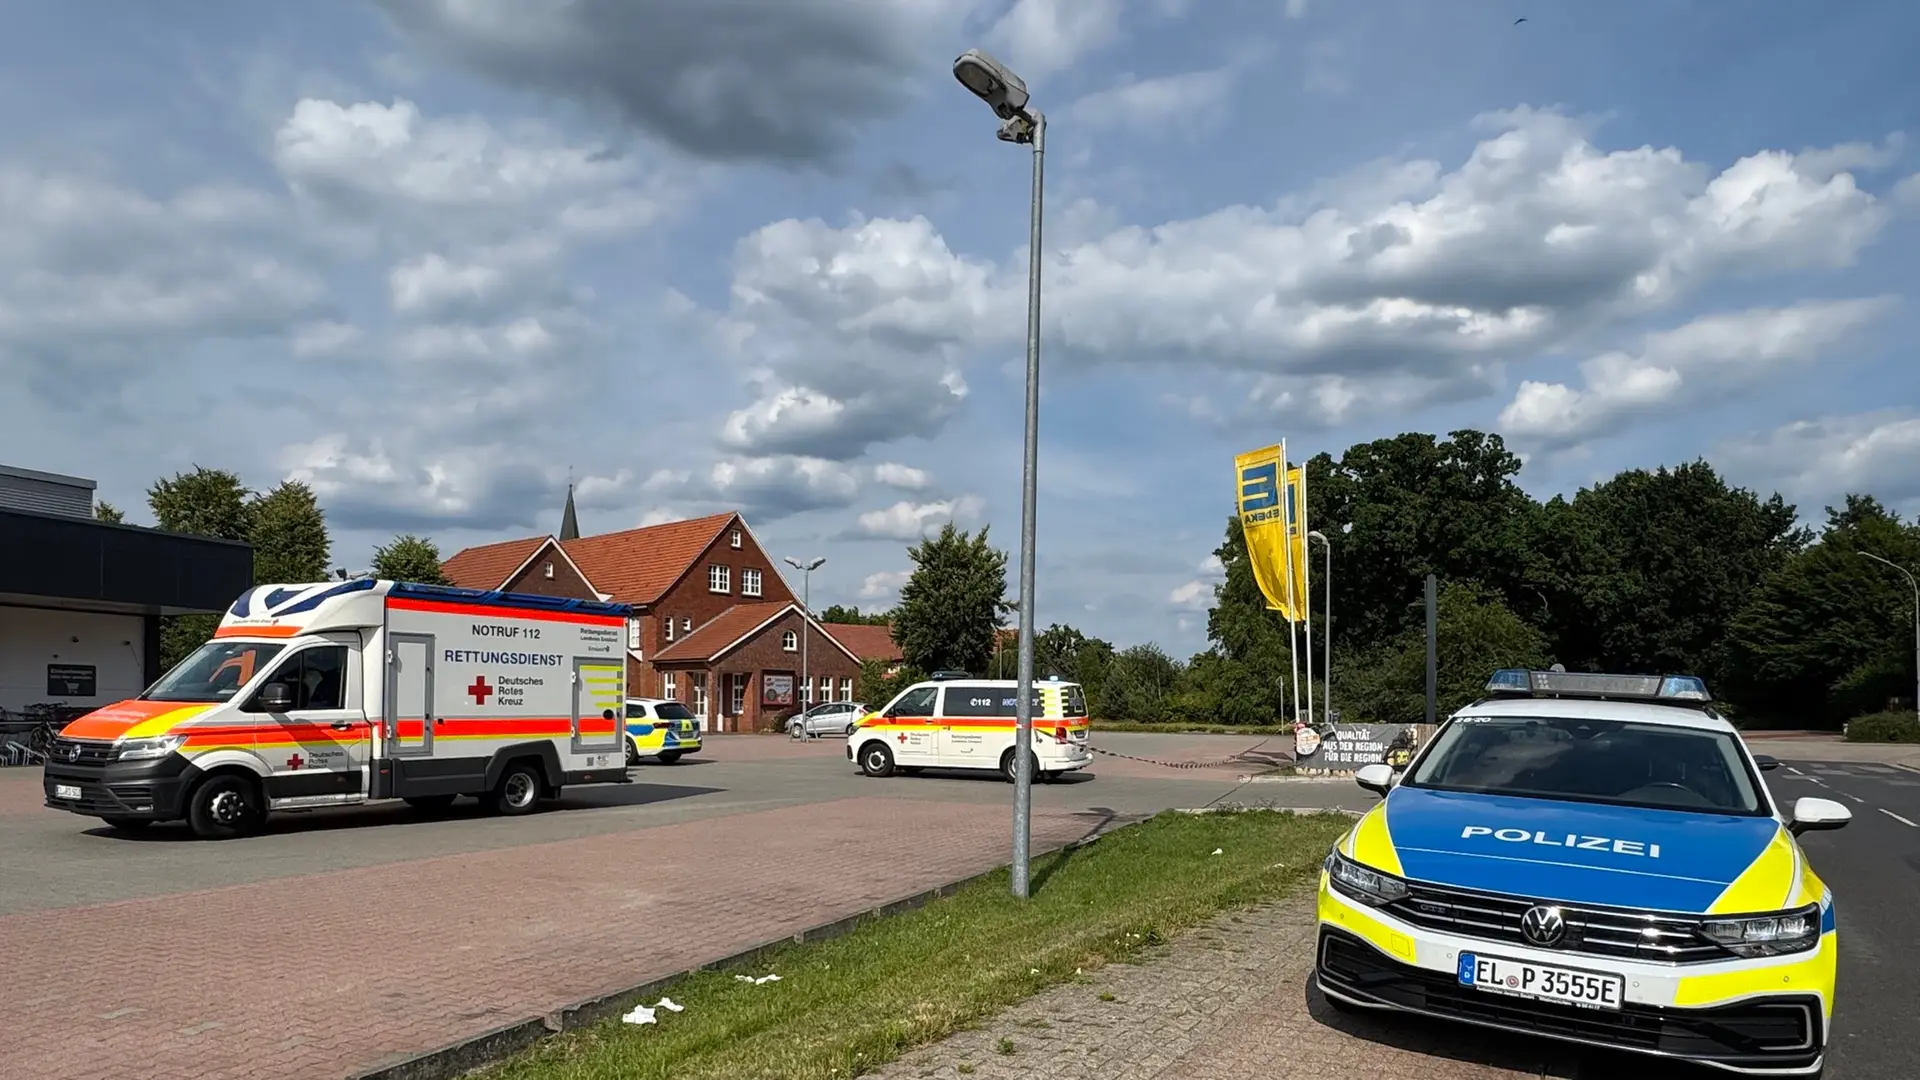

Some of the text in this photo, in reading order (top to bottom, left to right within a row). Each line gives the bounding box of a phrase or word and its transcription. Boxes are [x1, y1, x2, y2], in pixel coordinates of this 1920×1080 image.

[472, 624, 541, 640] NOTRUF 112
[444, 649, 563, 666] RETTUNGSDIENST
[498, 676, 544, 686] Deutsches
[498, 686, 524, 696] Rotes
[498, 696, 524, 706] Kreuz
[977, 698, 991, 707] 112
[1336, 729, 1371, 740] QUALITÄT
[1323, 741, 1338, 751] AUS
[1339, 741, 1354, 752] DER
[1355, 742, 1384, 752] REGION
[1324, 750, 1339, 762] FÜR
[1340, 752, 1352, 762] DIE
[1353, 753, 1385, 763] REGION.
[1460, 825, 1660, 859] POLIZEI
[1476, 960, 1504, 985] EL
[1522, 967, 1535, 989] P
[1541, 970, 1616, 1004] 3555E
